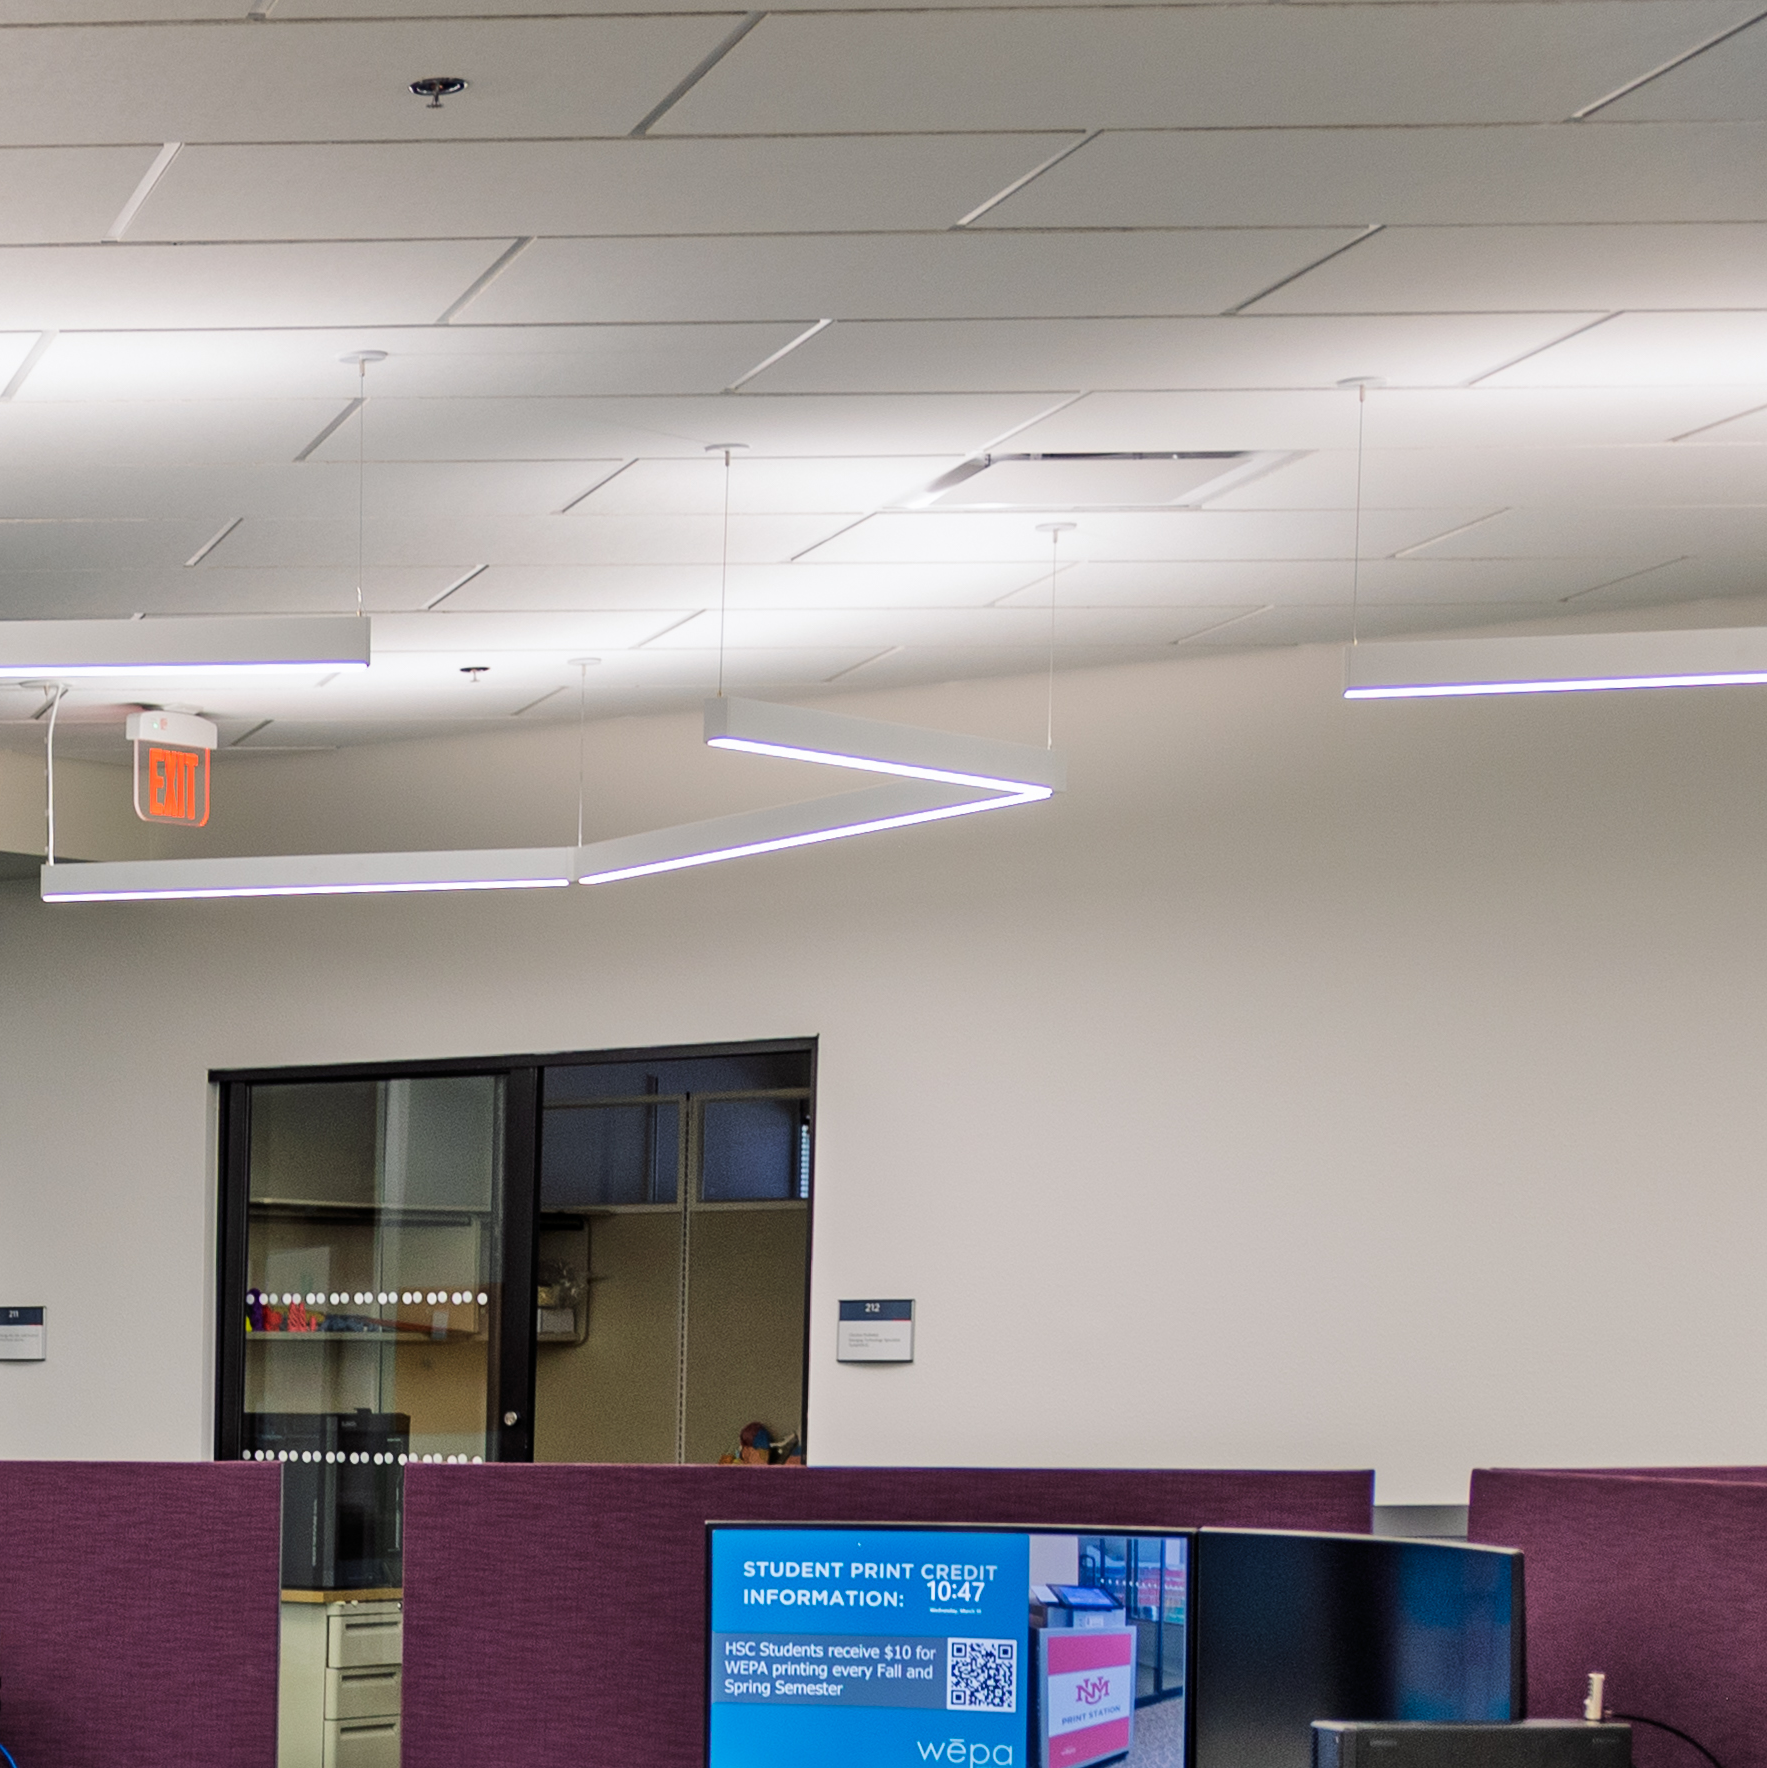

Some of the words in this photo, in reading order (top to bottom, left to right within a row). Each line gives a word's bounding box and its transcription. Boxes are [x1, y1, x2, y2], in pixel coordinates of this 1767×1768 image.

[149, 747, 199, 820] EXIT
[865, 1303, 880, 1312] 212
[743, 1561, 843, 1578] STUDENT
[851, 1563, 914, 1579] PRINT
[921, 1564, 998, 1581] CREDIT
[743, 1589, 904, 1607] INFORMATION:
[927, 1580, 985, 1602] 10:47
[725, 1641, 755, 1657] HSC
[759, 1641, 824, 1658] Students
[828, 1644, 880, 1659] receive
[884, 1644, 911, 1660] $10
[916, 1645, 936, 1660] for
[724, 1660, 768, 1675] WEPA
[772, 1661, 828, 1680] printing
[832, 1665, 873, 1681] every
[877, 1663, 902, 1679] Fall
[906, 1664, 933, 1680] and
[724, 1679, 771, 1697] Spring
[774, 1680, 843, 1696] Semester
[1061, 1712, 1087, 1725] PRINT
[1088, 1705, 1121, 1719] STATION
